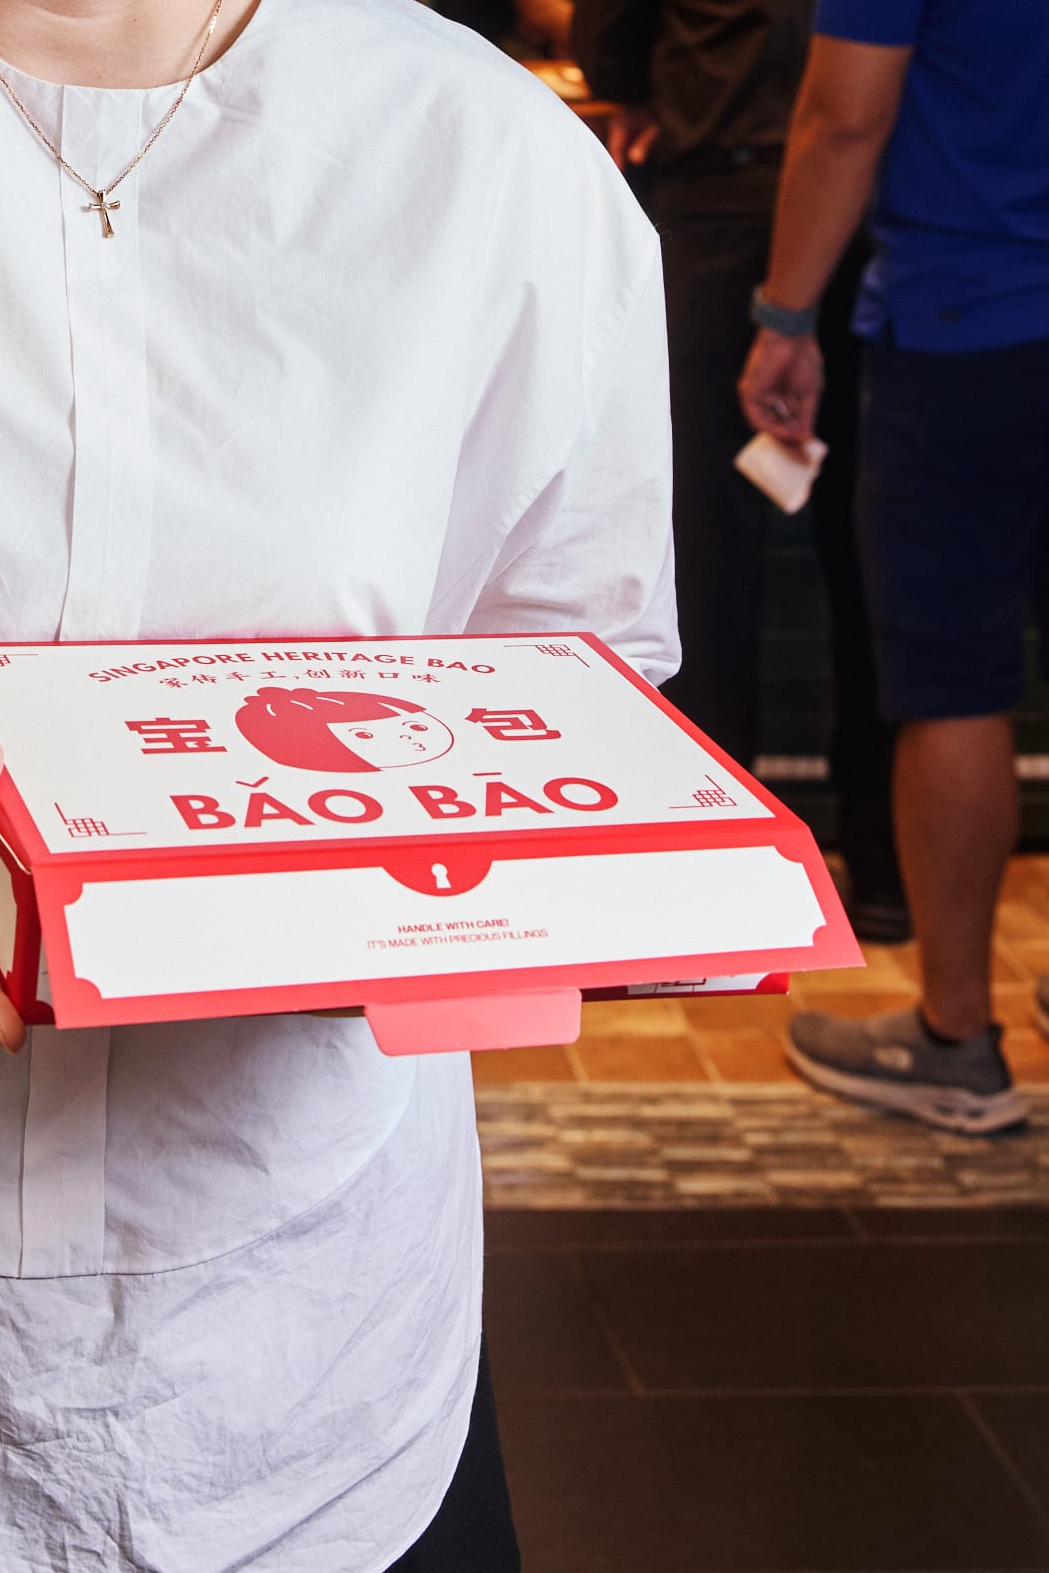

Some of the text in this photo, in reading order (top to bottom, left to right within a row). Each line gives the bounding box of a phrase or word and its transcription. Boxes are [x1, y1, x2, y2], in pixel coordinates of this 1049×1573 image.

[88, 651, 496, 684] SINGAPORE HERITAGE BAO
[124, 707, 562, 756] 宝 包
[408, 771, 619, 822] BĀO
[367, 928, 549, 950] IT'S MADE WITH PRECIOUS FILLINGS
[398, 918, 509, 934] HANDLE WITH CARE!
